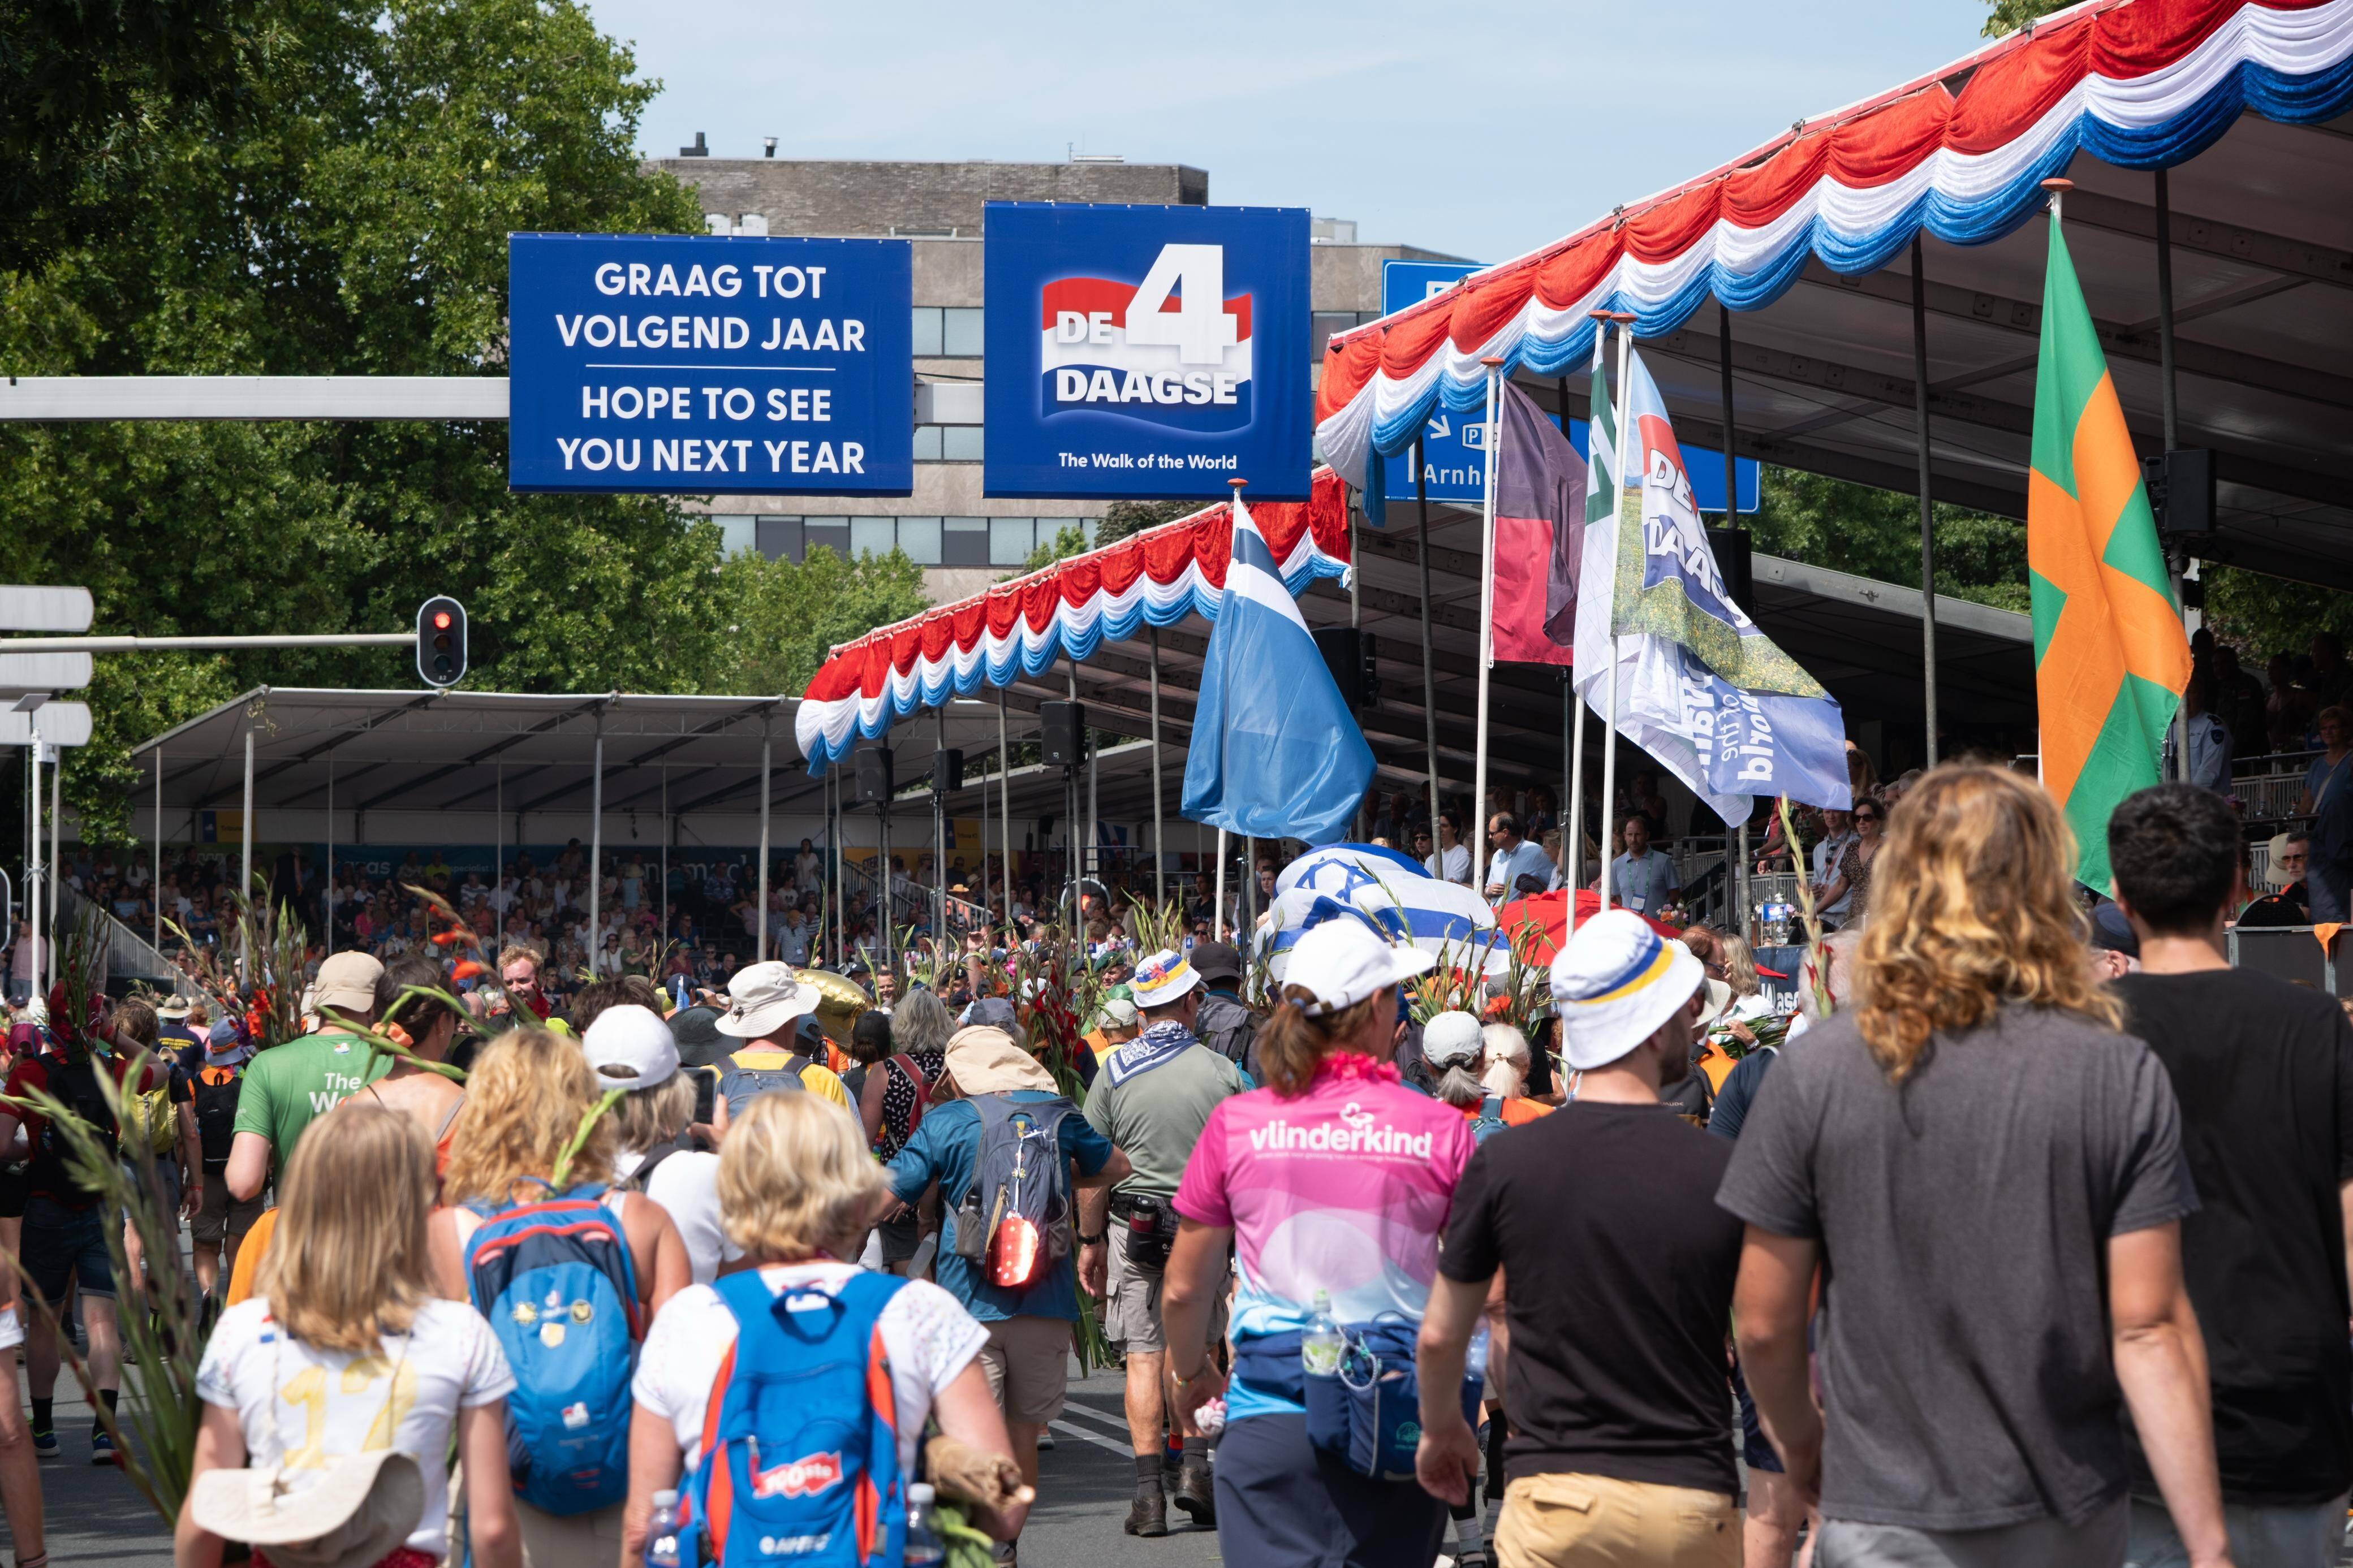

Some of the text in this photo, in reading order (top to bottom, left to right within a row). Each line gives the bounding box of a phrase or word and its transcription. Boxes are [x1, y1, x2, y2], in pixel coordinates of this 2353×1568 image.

[595, 262, 826, 299] GRAAG TOT
[1057, 243, 1238, 365] DE 4
[555, 314, 865, 351] VOLGEND JAAR
[583, 386, 831, 421] HOPE TO SEE
[1056, 369, 1238, 405] DAAGSE
[557, 438, 865, 474] YOU NEXT YEAR
[1058, 452, 1236, 469] The Walk of the World
[1424, 464, 1496, 486] Arnh
[1649, 448, 1692, 512] DE
[324, 1073, 361, 1090] The
[1249, 1120, 1433, 1158] vlinderkind
